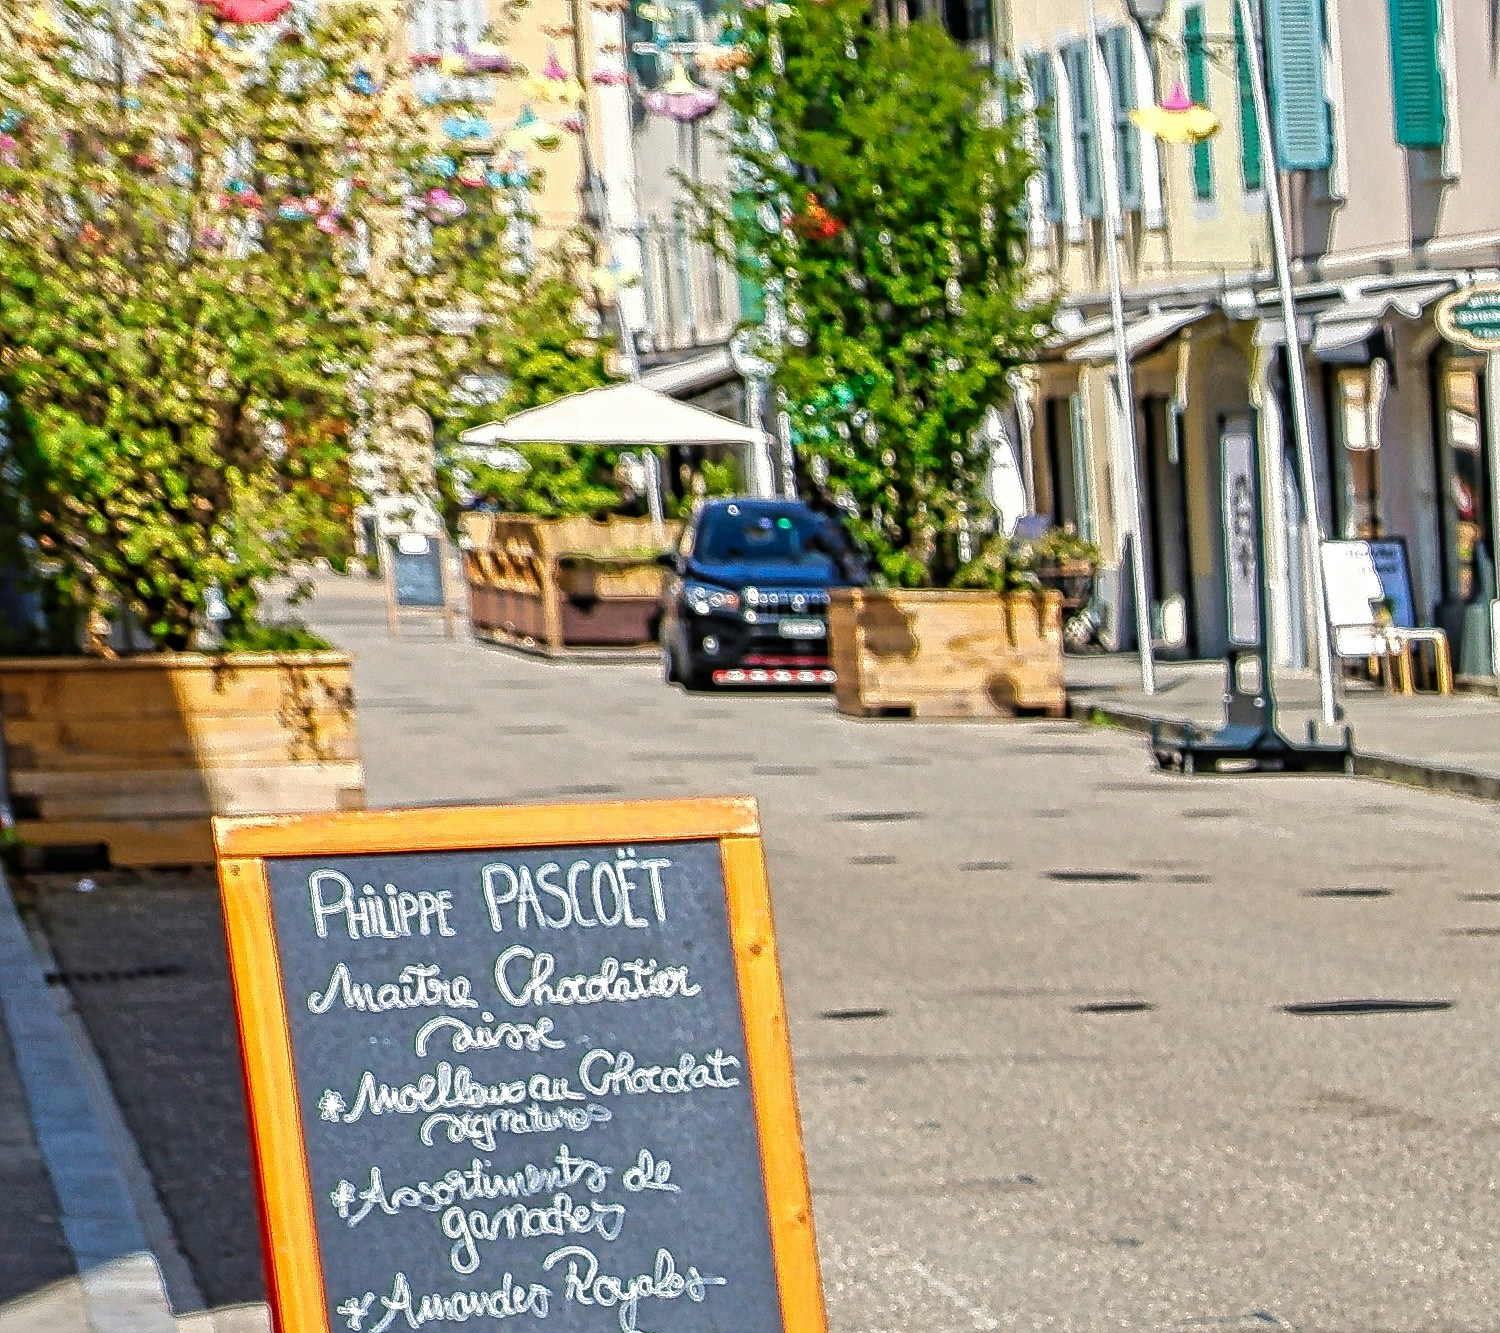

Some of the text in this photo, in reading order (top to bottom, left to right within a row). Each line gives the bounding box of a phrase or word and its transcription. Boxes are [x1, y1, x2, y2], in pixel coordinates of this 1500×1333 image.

[481, 847, 673, 933] PASCOËT
[527, 1073, 586, 1102] au
[578, 1047, 742, 1097] Chocolat
[348, 1144, 682, 1228] Assortiments de
[543, 1245, 728, 1333] Royales
